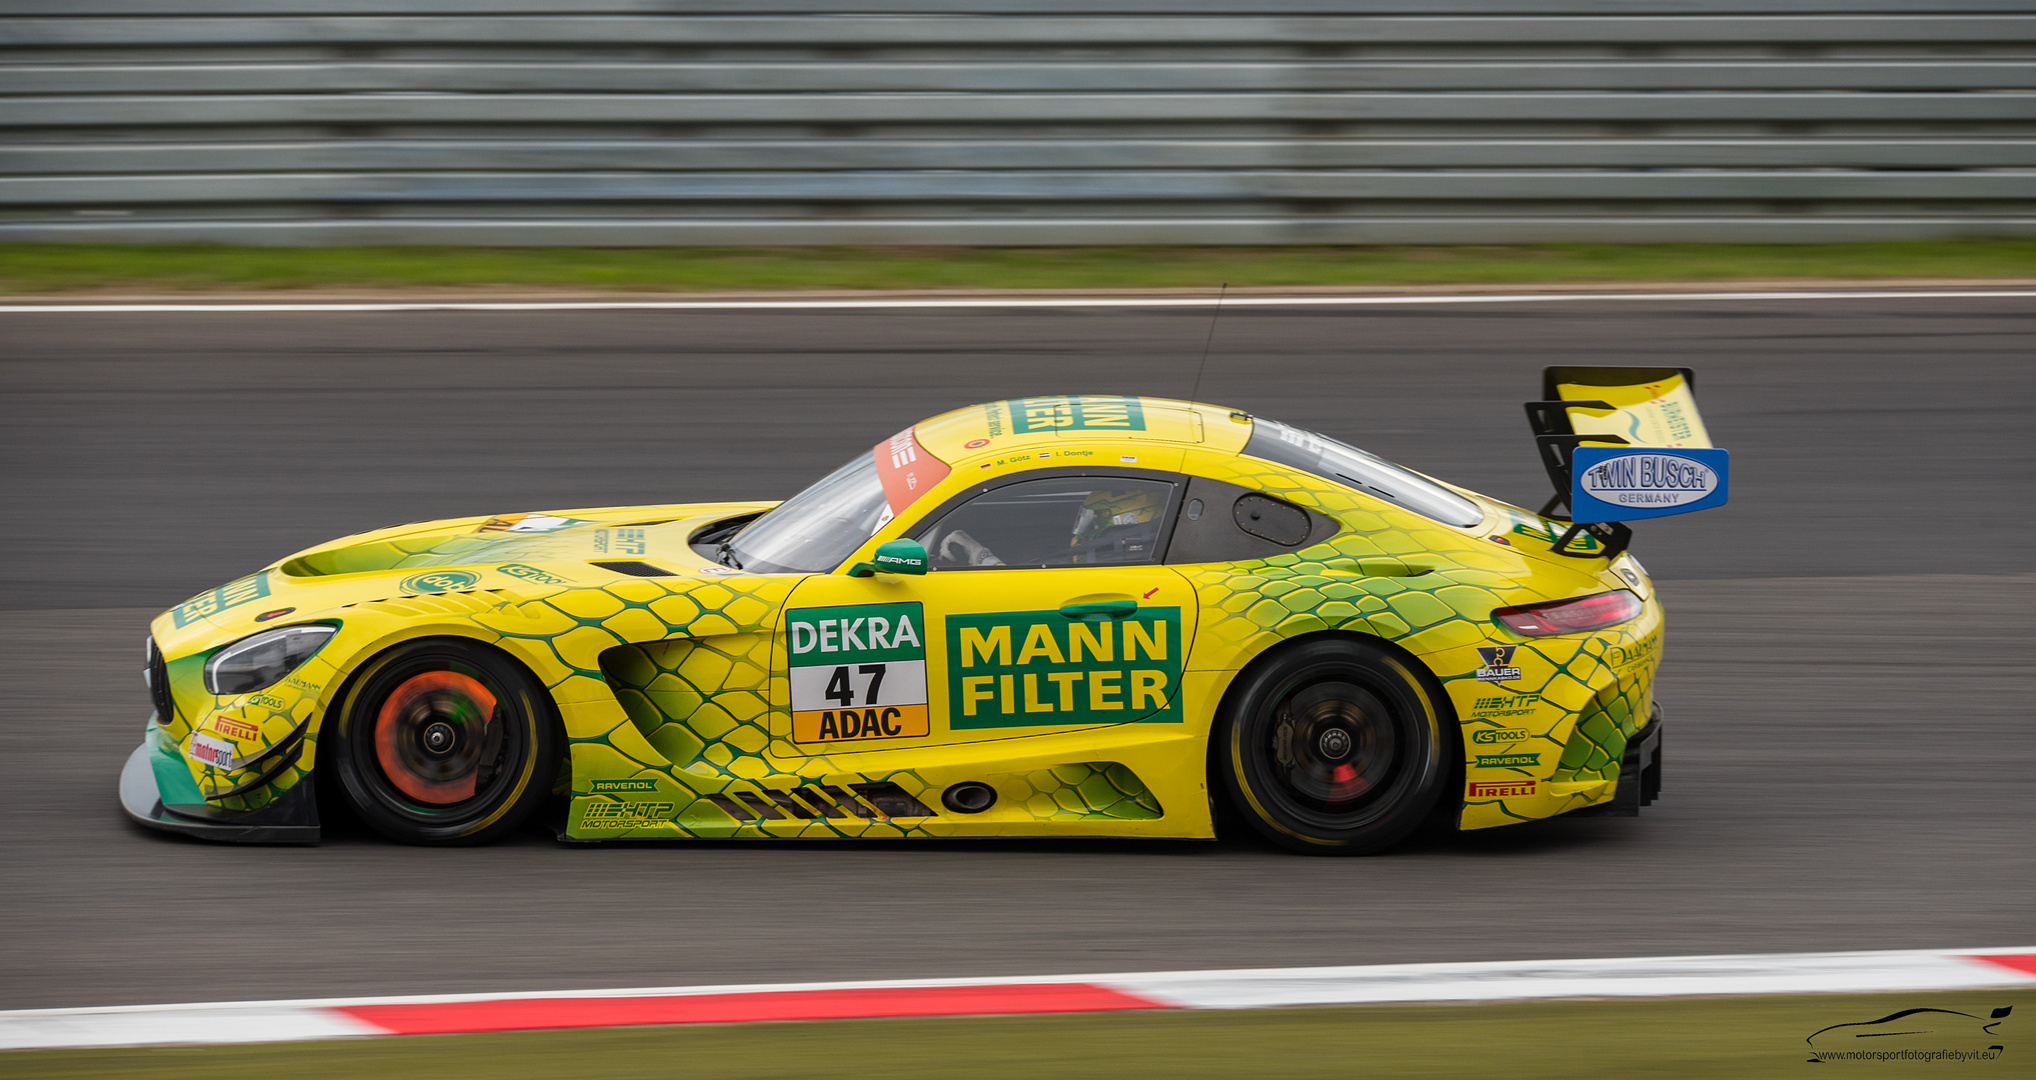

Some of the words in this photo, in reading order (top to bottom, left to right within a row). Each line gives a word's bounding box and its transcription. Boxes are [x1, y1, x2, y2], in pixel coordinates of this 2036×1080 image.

[1010, 454, 1031, 463] Götz
[1587, 457, 1636, 488] TWIN
[1641, 456, 1706, 488] BUSCH
[1618, 492, 1680, 503] GERMANY
[889, 557, 922, 566] AMG
[791, 614, 921, 655] DEKRA
[959, 619, 1168, 668] MANN
[1476, 668, 1521, 677] BAUER
[825, 663, 886, 707] 47
[961, 669, 1171, 716] FILTER
[259, 696, 283, 709] TOOLS
[1472, 708, 1537, 718] MOTORSPORT
[214, 715, 259, 742] PIRELLI
[819, 707, 902, 740] ADAC
[1476, 732, 1495, 743] KS
[1495, 730, 1527, 741] TOOLS
[1480, 756, 1536, 766] RAVENOL
[596, 781, 653, 790] RAVENOL
[1468, 780, 1537, 797] PIRELLI
[581, 819, 670, 829] MOTORSPORT
